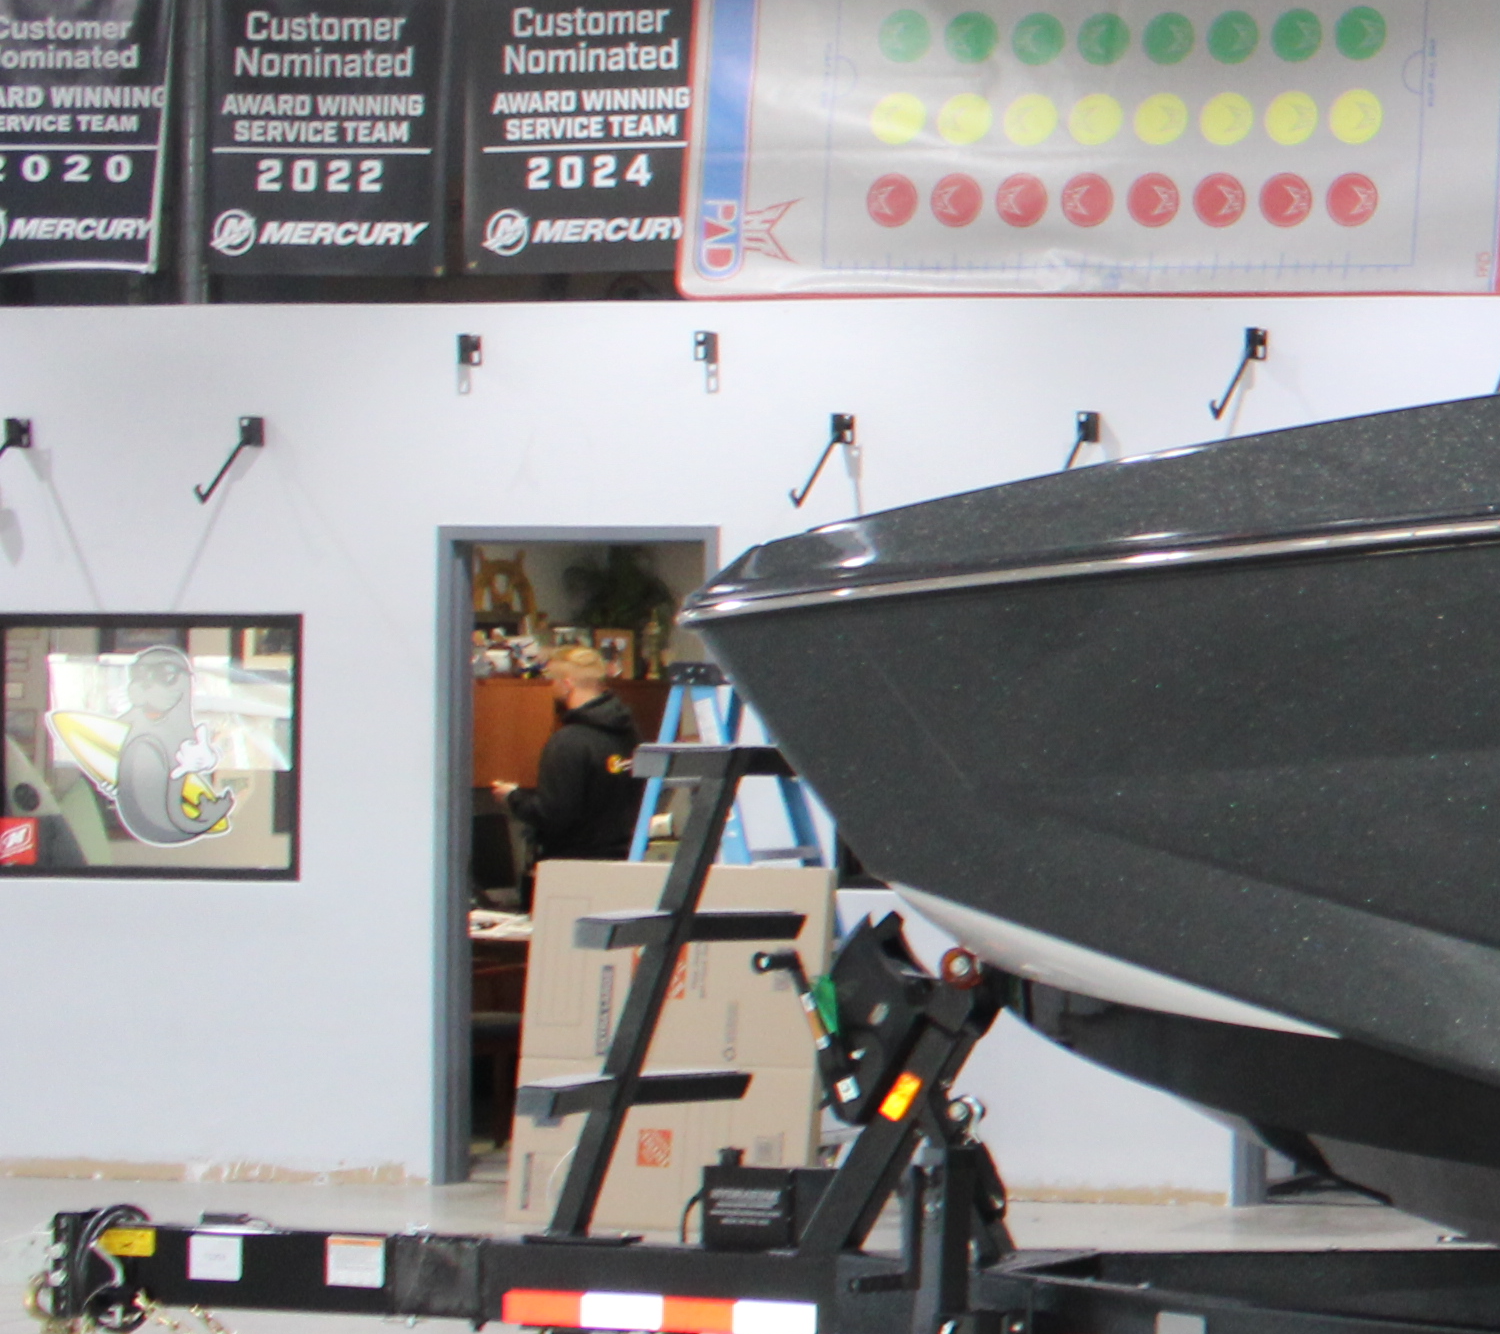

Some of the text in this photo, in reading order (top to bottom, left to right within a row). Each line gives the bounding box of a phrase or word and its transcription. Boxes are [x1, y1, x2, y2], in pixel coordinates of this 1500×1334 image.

[245, 10, 407, 42] Customer
[511, 6, 671, 38] Customer
[0, 43, 140, 69] ominated
[234, 46, 415, 78] Nominated
[503, 37, 680, 75] Nominated
[52, 85, 167, 109] WINNING
[222, 93, 425, 116] AWARD WINNING
[492, 86, 691, 115] AWARD WINNING
[0, 114, 140, 133] RVICE TEAM
[233, 120, 410, 143] SERVICE TEAM
[505, 114, 678, 141] SERVICE TEAM
[0, 153, 133, 183] 020
[256, 158, 384, 193] 2022
[526, 153, 653, 190] 2024
[9, 217, 152, 241] MERCURY
[258, 220, 430, 246] MERCURY
[702, 198, 738, 272] PAD
